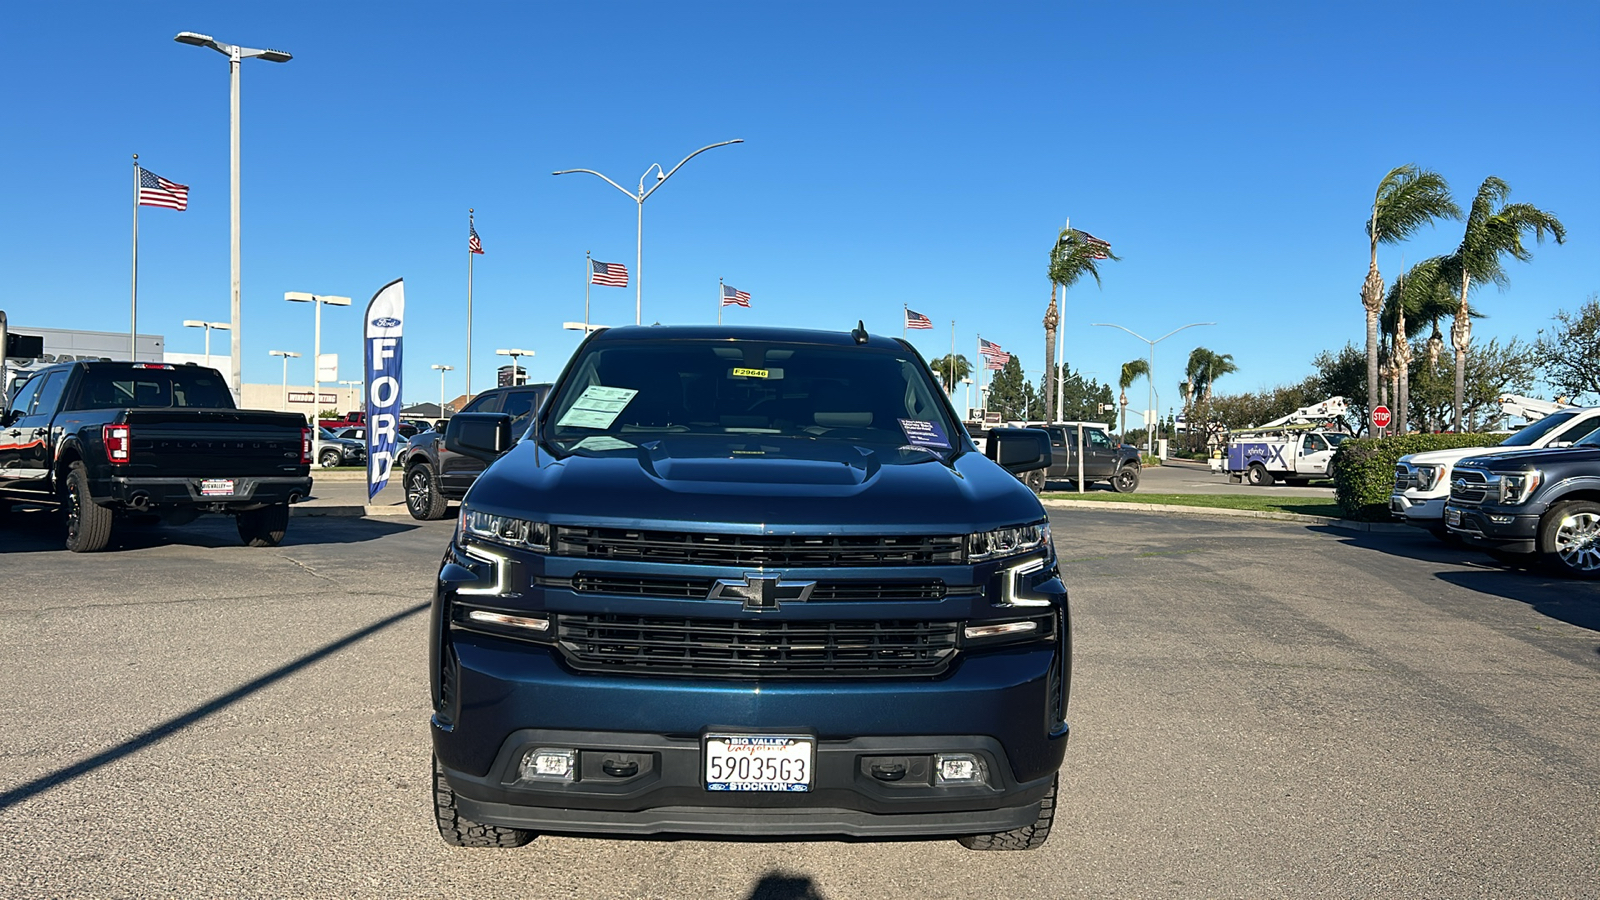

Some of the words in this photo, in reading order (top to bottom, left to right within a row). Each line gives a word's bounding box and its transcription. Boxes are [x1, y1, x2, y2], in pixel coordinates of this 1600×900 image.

[375, 317, 397, 327] Ford
[734, 369, 767, 377] F29646
[370, 338, 399, 483] FORD
[1374, 412, 1390, 421] STOP
[161, 441, 277, 449] PLATINUM
[1247, 447, 1265, 456] xfinity
[711, 756, 805, 782] 59035G3
[729, 782, 788, 791] STOCKTON
